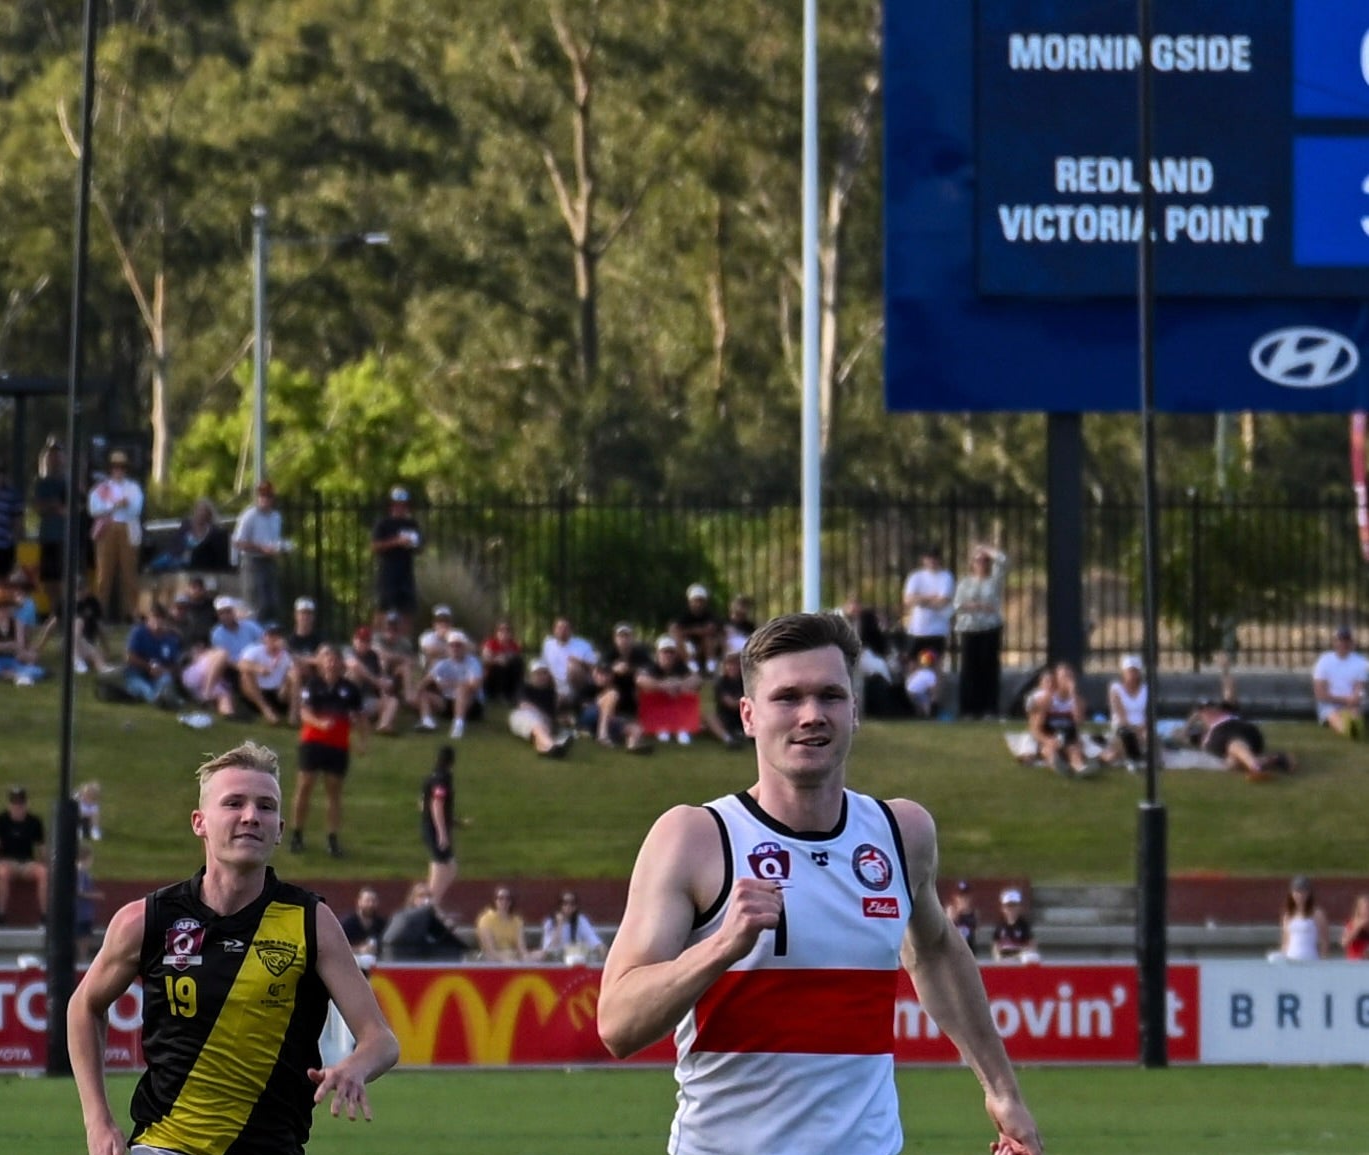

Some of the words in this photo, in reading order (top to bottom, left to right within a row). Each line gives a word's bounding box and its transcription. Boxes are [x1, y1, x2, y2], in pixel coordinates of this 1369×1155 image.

[1008, 34, 1252, 72] MORNINGSIDE
[998, 204, 1157, 242] VICTORIA
[1165, 205, 1270, 243] POINT
[164, 975, 197, 1019] 19
[990, 983, 1126, 1039] ovin'
